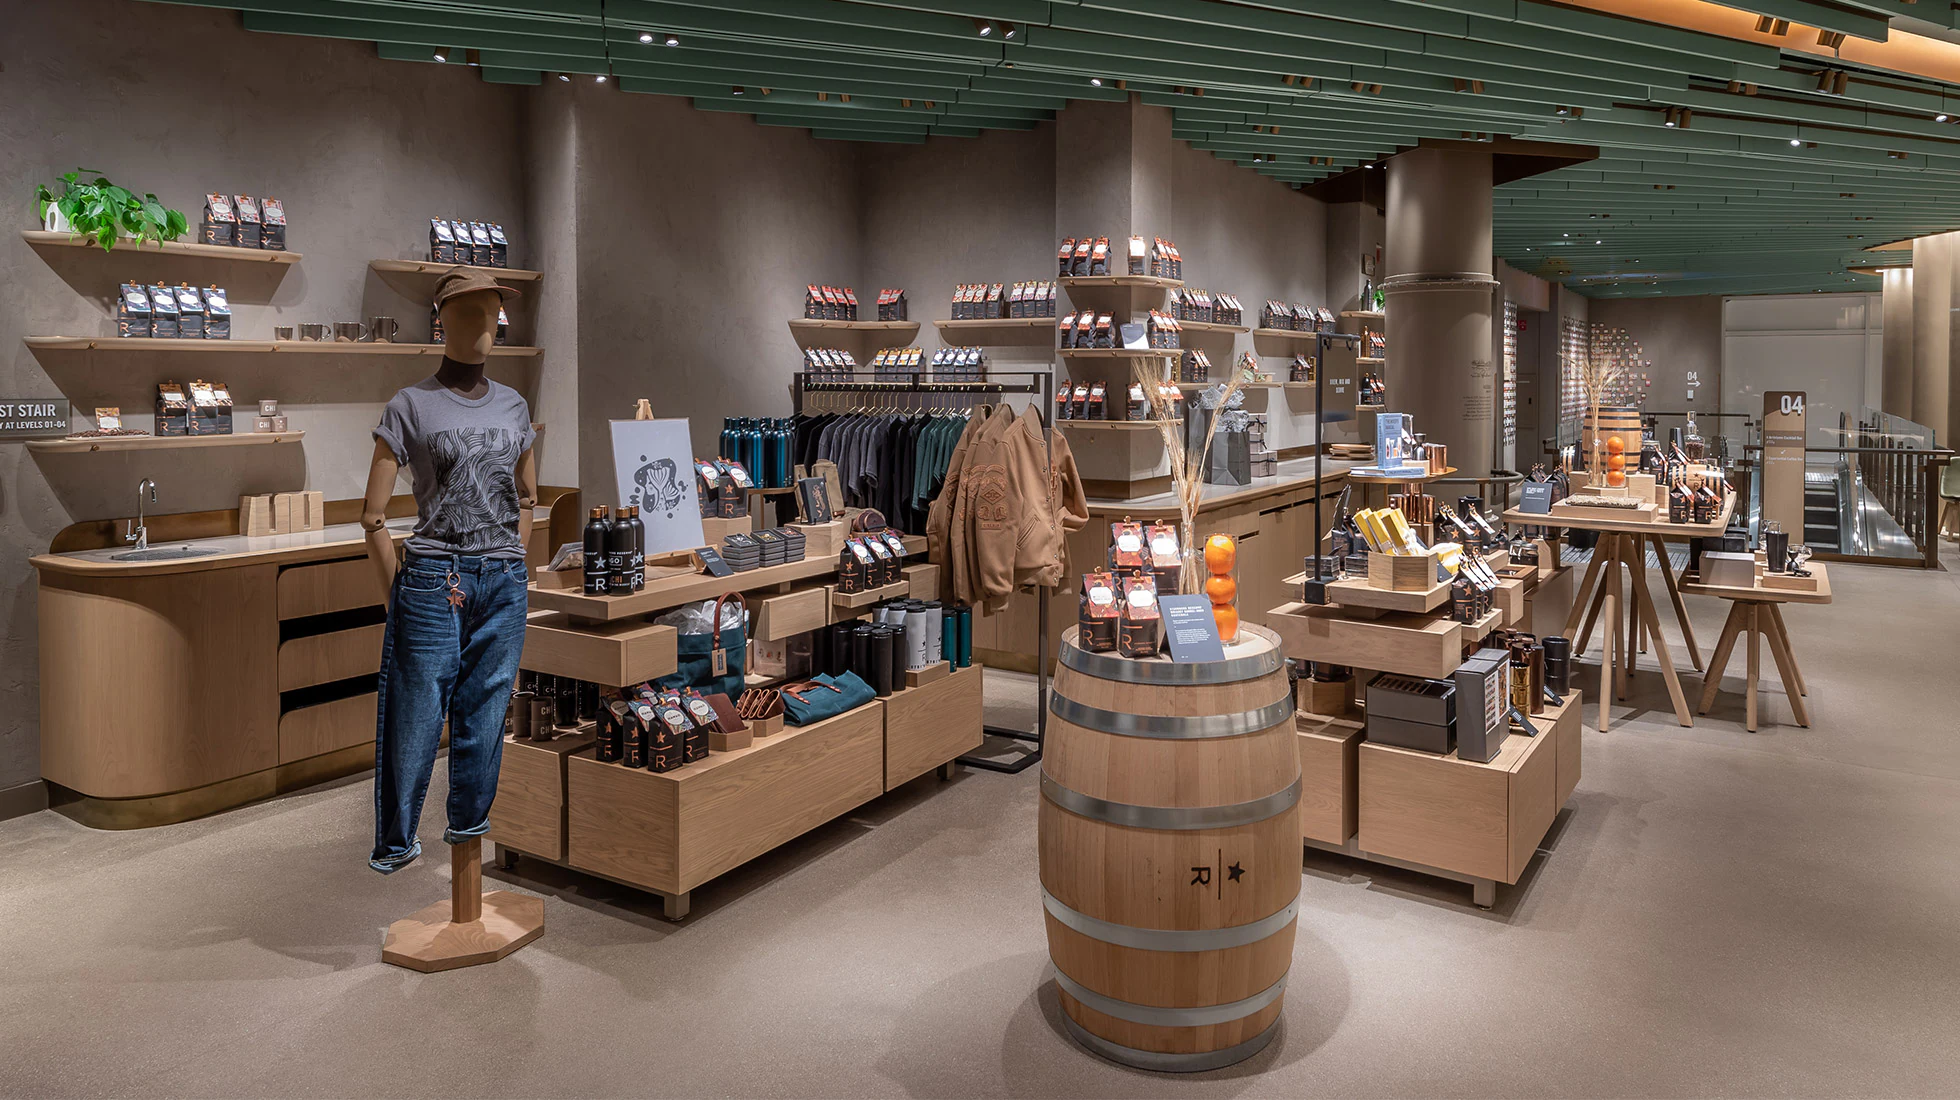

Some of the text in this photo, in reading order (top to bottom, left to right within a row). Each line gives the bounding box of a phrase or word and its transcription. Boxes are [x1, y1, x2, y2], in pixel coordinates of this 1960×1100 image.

[206, 230, 215, 241] R
[120, 321, 130, 333] R
[1687, 371, 1697, 381] 04
[18, 404, 56, 417] STAIR
[1781, 395, 1803, 415] 04
[16, 421, 43, 429] LEVELS
[44, 420, 66, 428] 01-04
[161, 421, 168, 432] R
[191, 420, 199, 431] R
[725, 503, 734, 514] R
[595, 578, 607, 591] R
[635, 573, 644, 585] R
[845, 579, 854, 590] R
[1465, 606, 1473, 618] R
[1082, 629, 1093, 646] R
[1121, 634, 1132, 650] R
[655, 755, 666, 768] R
[1191, 867, 1211, 886] R
